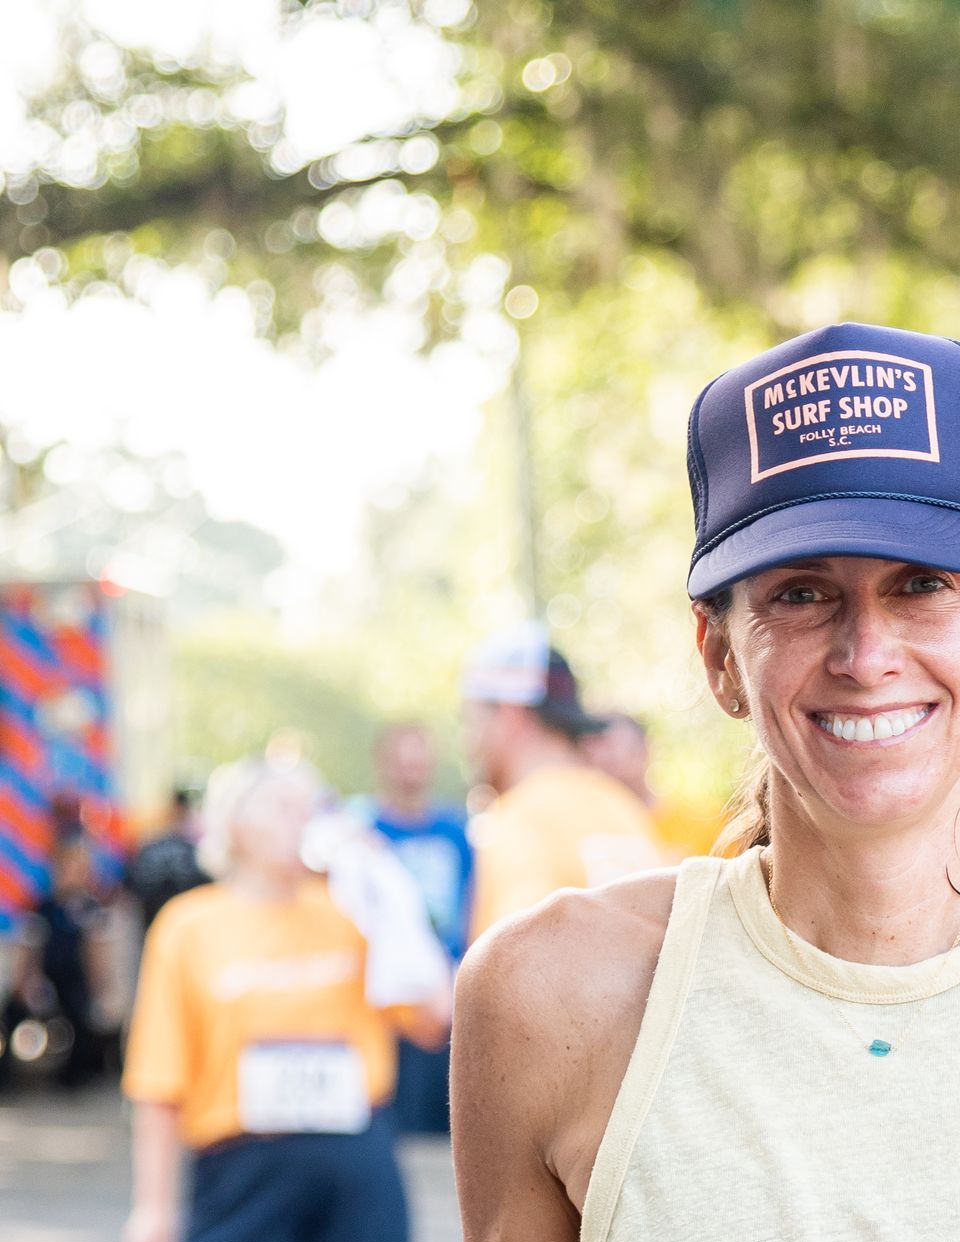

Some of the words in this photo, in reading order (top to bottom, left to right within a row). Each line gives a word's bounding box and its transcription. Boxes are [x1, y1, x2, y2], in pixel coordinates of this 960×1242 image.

[772, 399, 831, 435] SURF
[839, 396, 908, 419] SHOP
[800, 428, 835, 443] FOLLY
[840, 424, 881, 436] BEACH
[829, 436, 852, 447] S.C.
